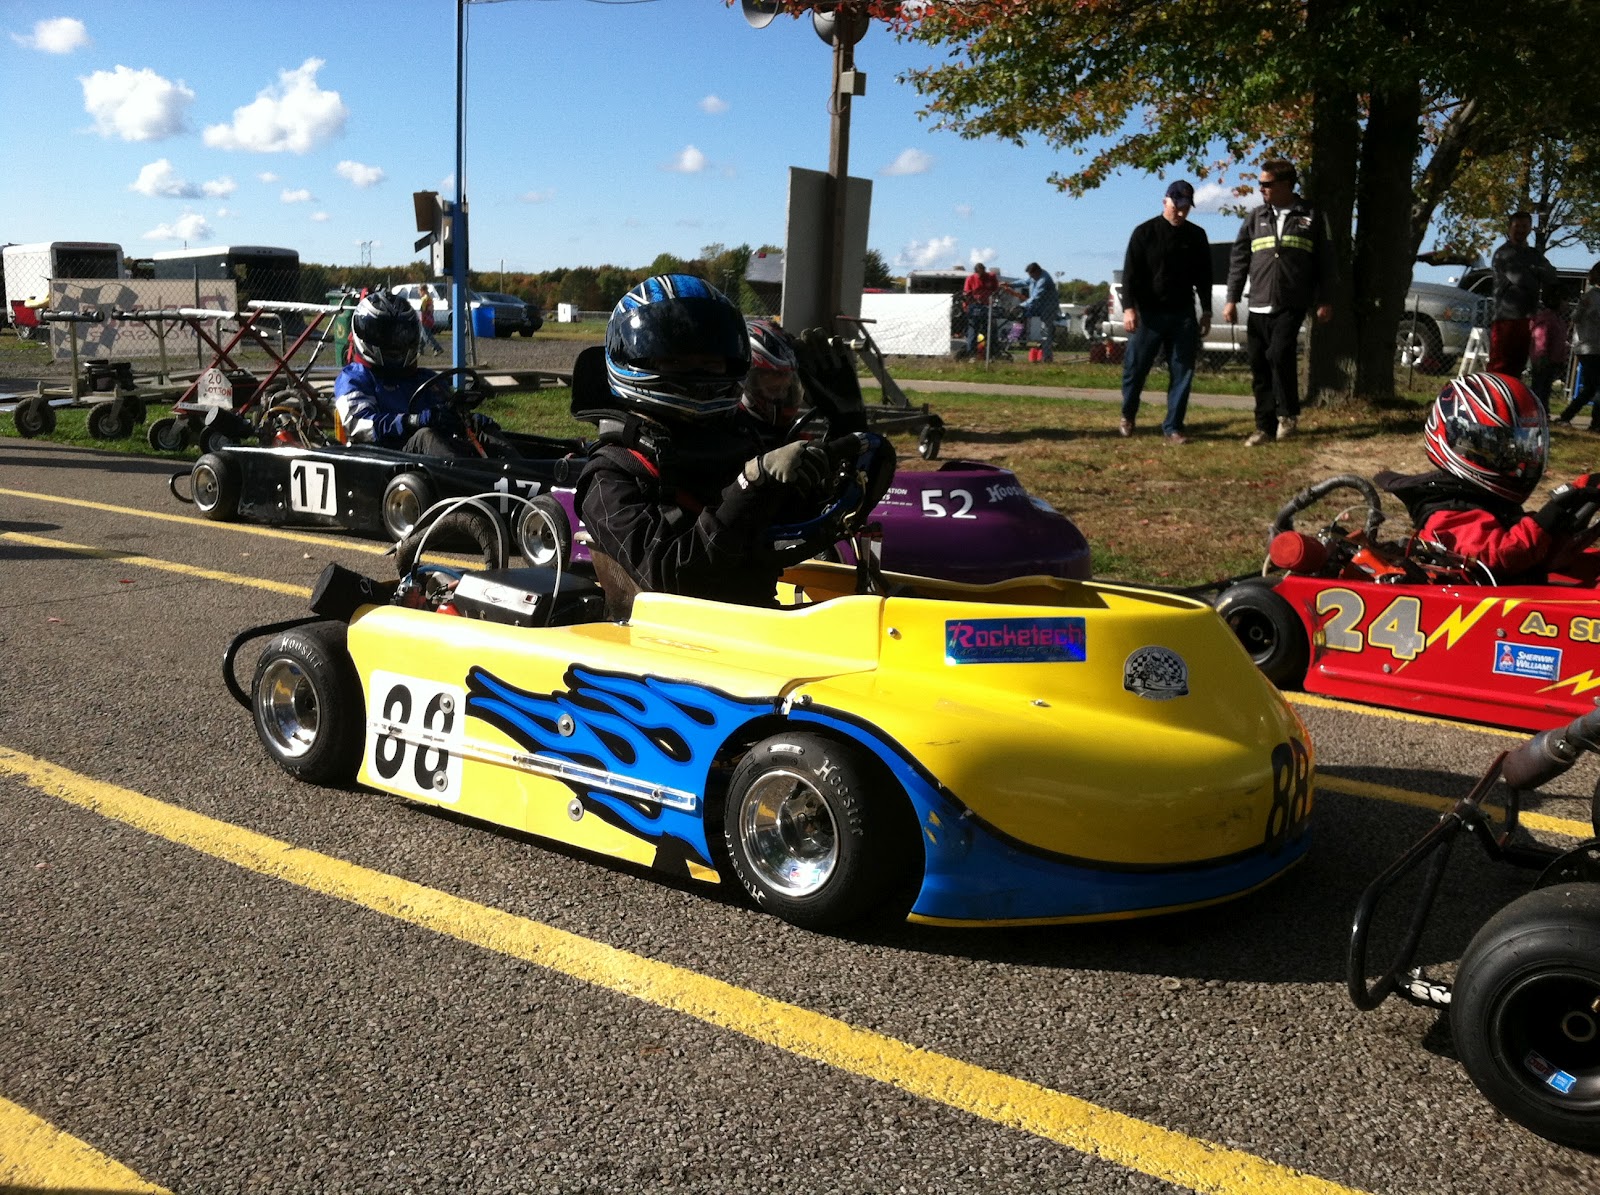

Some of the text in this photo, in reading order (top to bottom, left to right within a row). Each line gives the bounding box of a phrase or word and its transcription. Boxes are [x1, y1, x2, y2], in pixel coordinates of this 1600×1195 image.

[208, 373, 222, 385] 20
[293, 465, 330, 510] 17
[921, 489, 978, 519] 52
[948, 622, 1084, 648] Rocketech
[1316, 587, 1426, 661] 24
[375, 684, 456, 792] 88
[1264, 736, 1309, 850] 88
